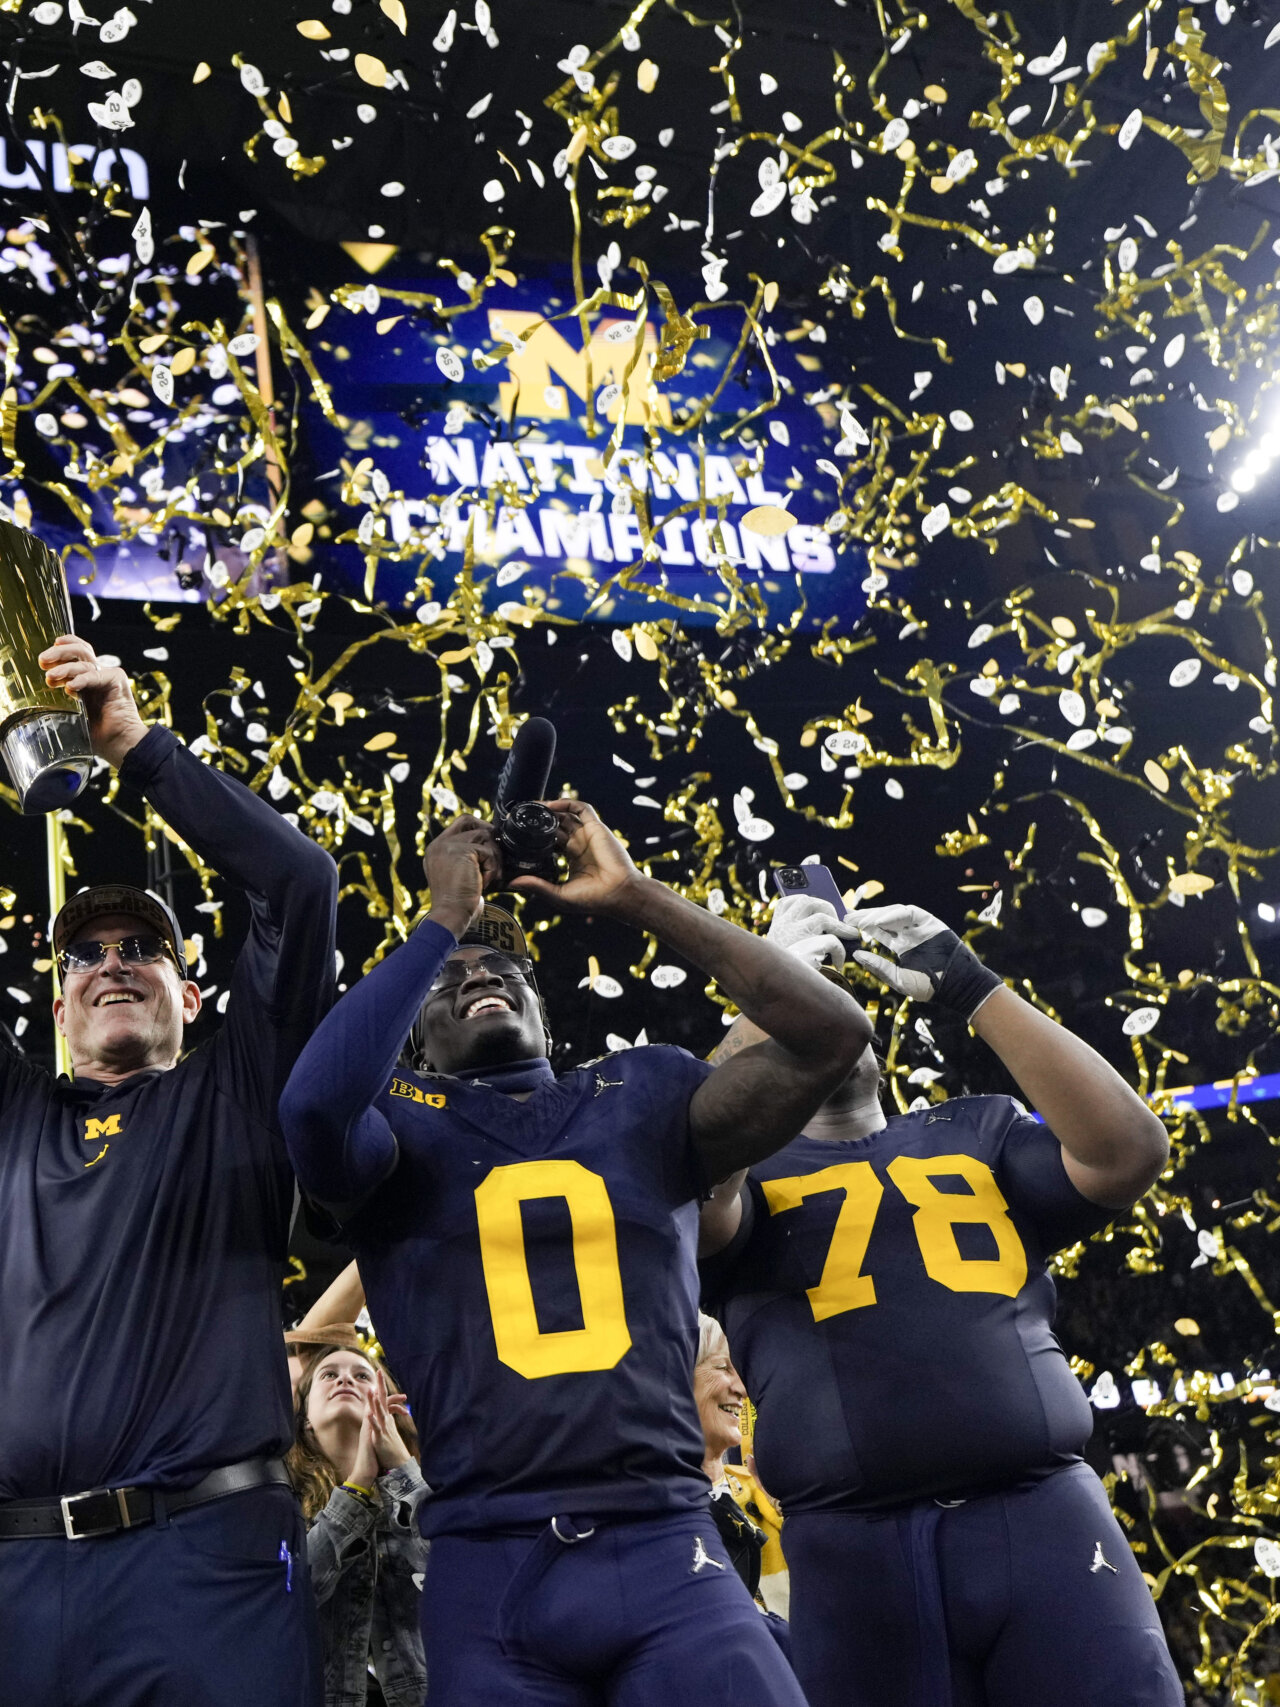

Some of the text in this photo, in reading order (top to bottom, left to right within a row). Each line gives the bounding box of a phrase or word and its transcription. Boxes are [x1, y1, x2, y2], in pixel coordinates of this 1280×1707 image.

[488, 308, 673, 426] M
[427, 436, 785, 506] NATIONAL
[388, 498, 838, 575] CHAMPIONS
[84, 1113, 121, 1140] M
[475, 1160, 631, 1380] 0
[760, 1154, 1028, 1323] 78
